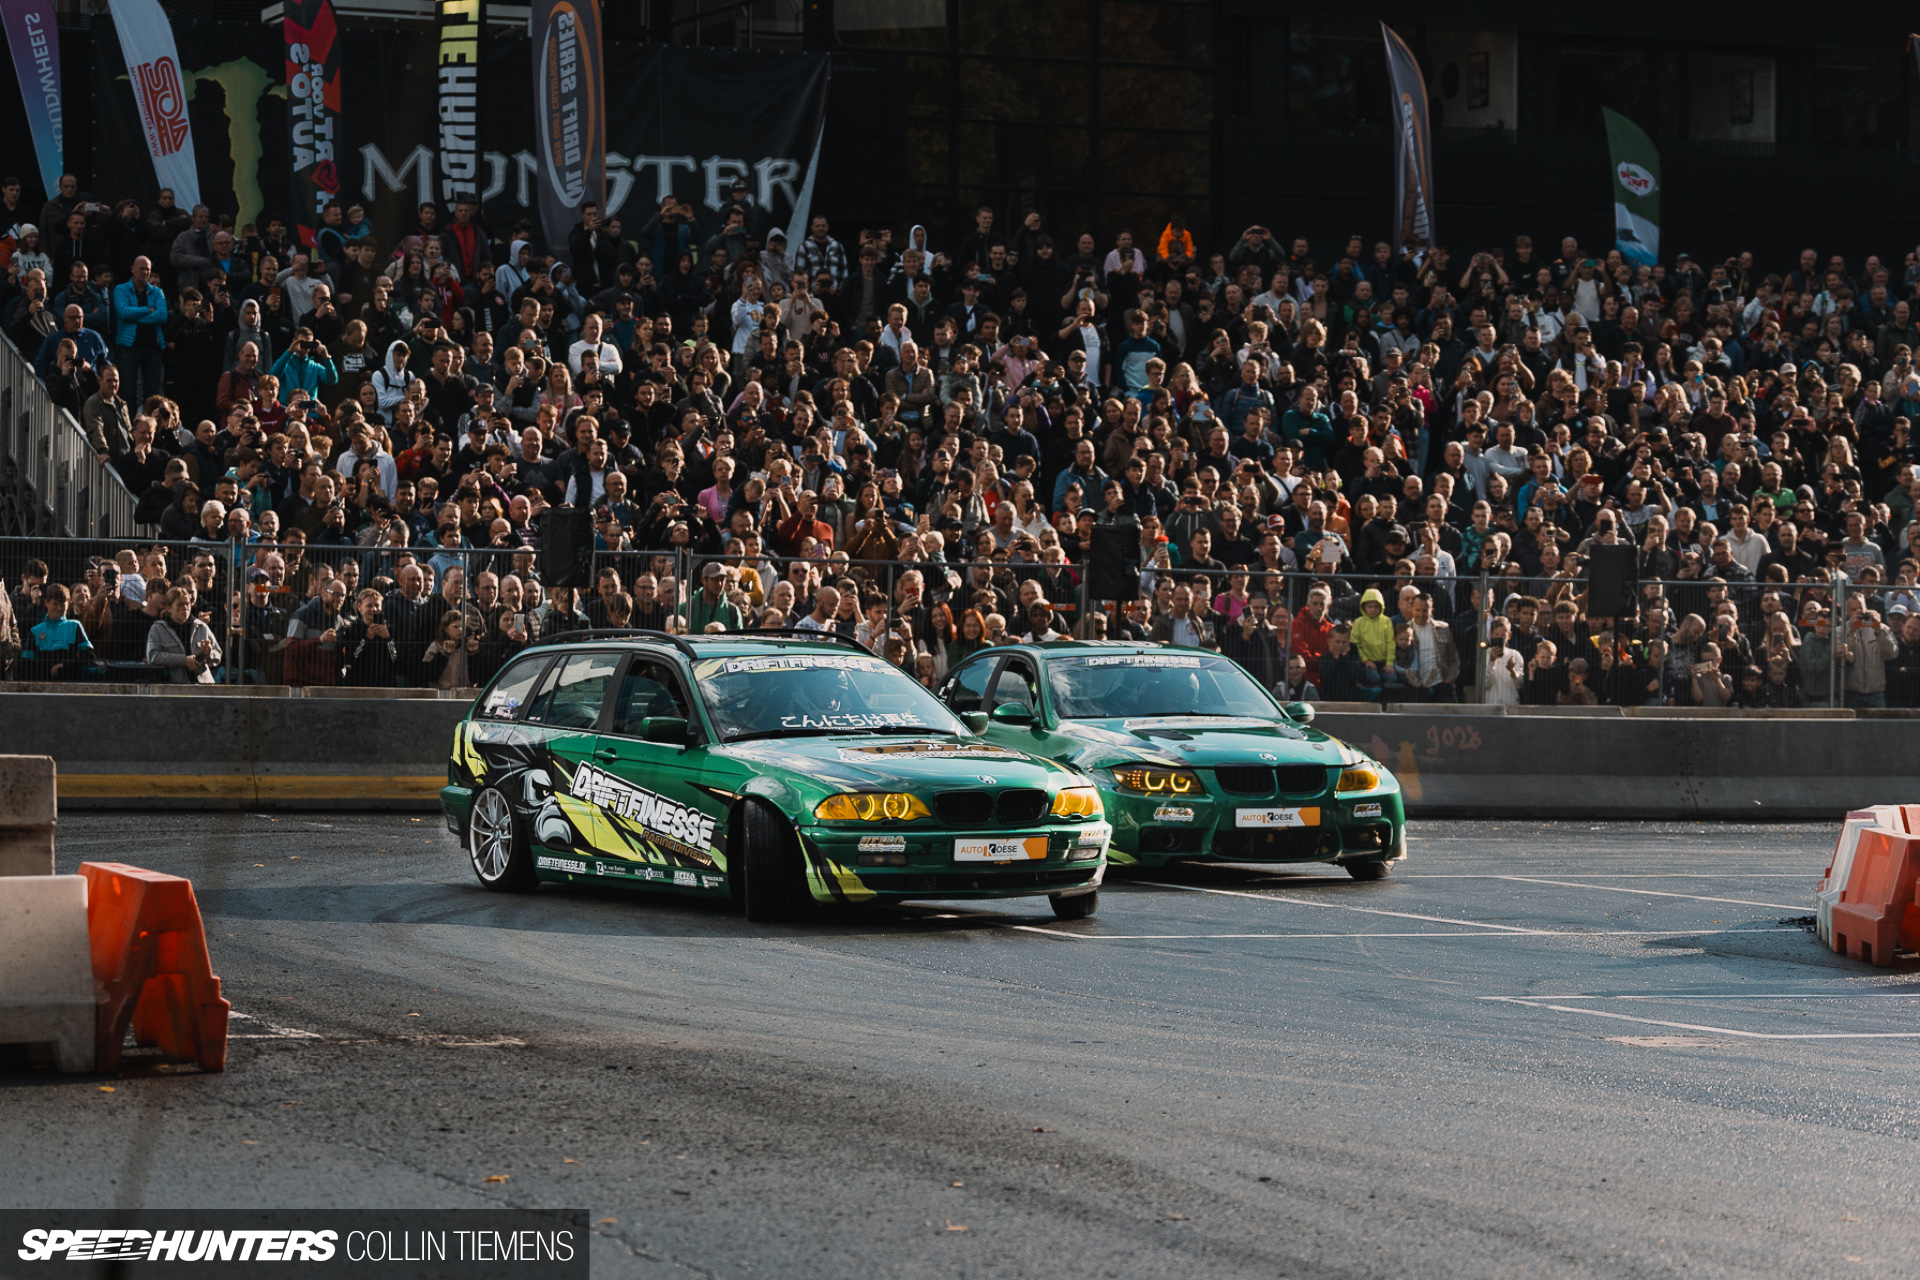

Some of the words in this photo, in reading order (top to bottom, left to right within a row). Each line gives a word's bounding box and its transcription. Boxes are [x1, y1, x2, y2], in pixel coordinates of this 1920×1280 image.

[483, 307, 493, 332] YAMAHA
[642, 829, 676, 849] RACING
[674, 843, 713, 866] DIVISION
